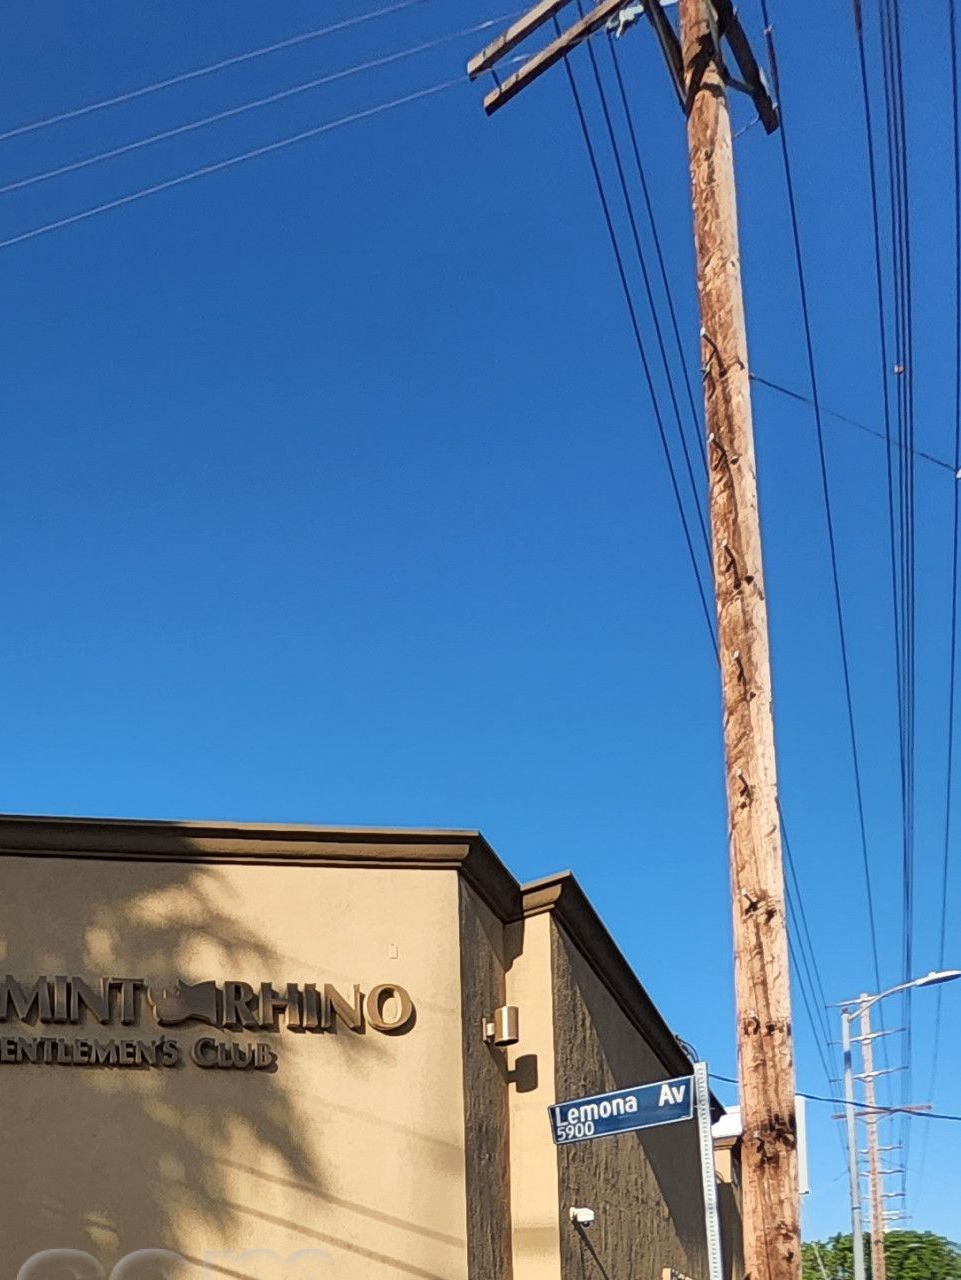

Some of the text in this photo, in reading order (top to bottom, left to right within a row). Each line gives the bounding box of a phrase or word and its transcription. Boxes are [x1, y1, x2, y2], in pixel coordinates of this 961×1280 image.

[222, 981, 413, 1031] RHINO
[189, 1037, 274, 1069] CLUB
[555, 1083, 687, 1128] Lemona Av
[557, 1121, 595, 1141] 5900
